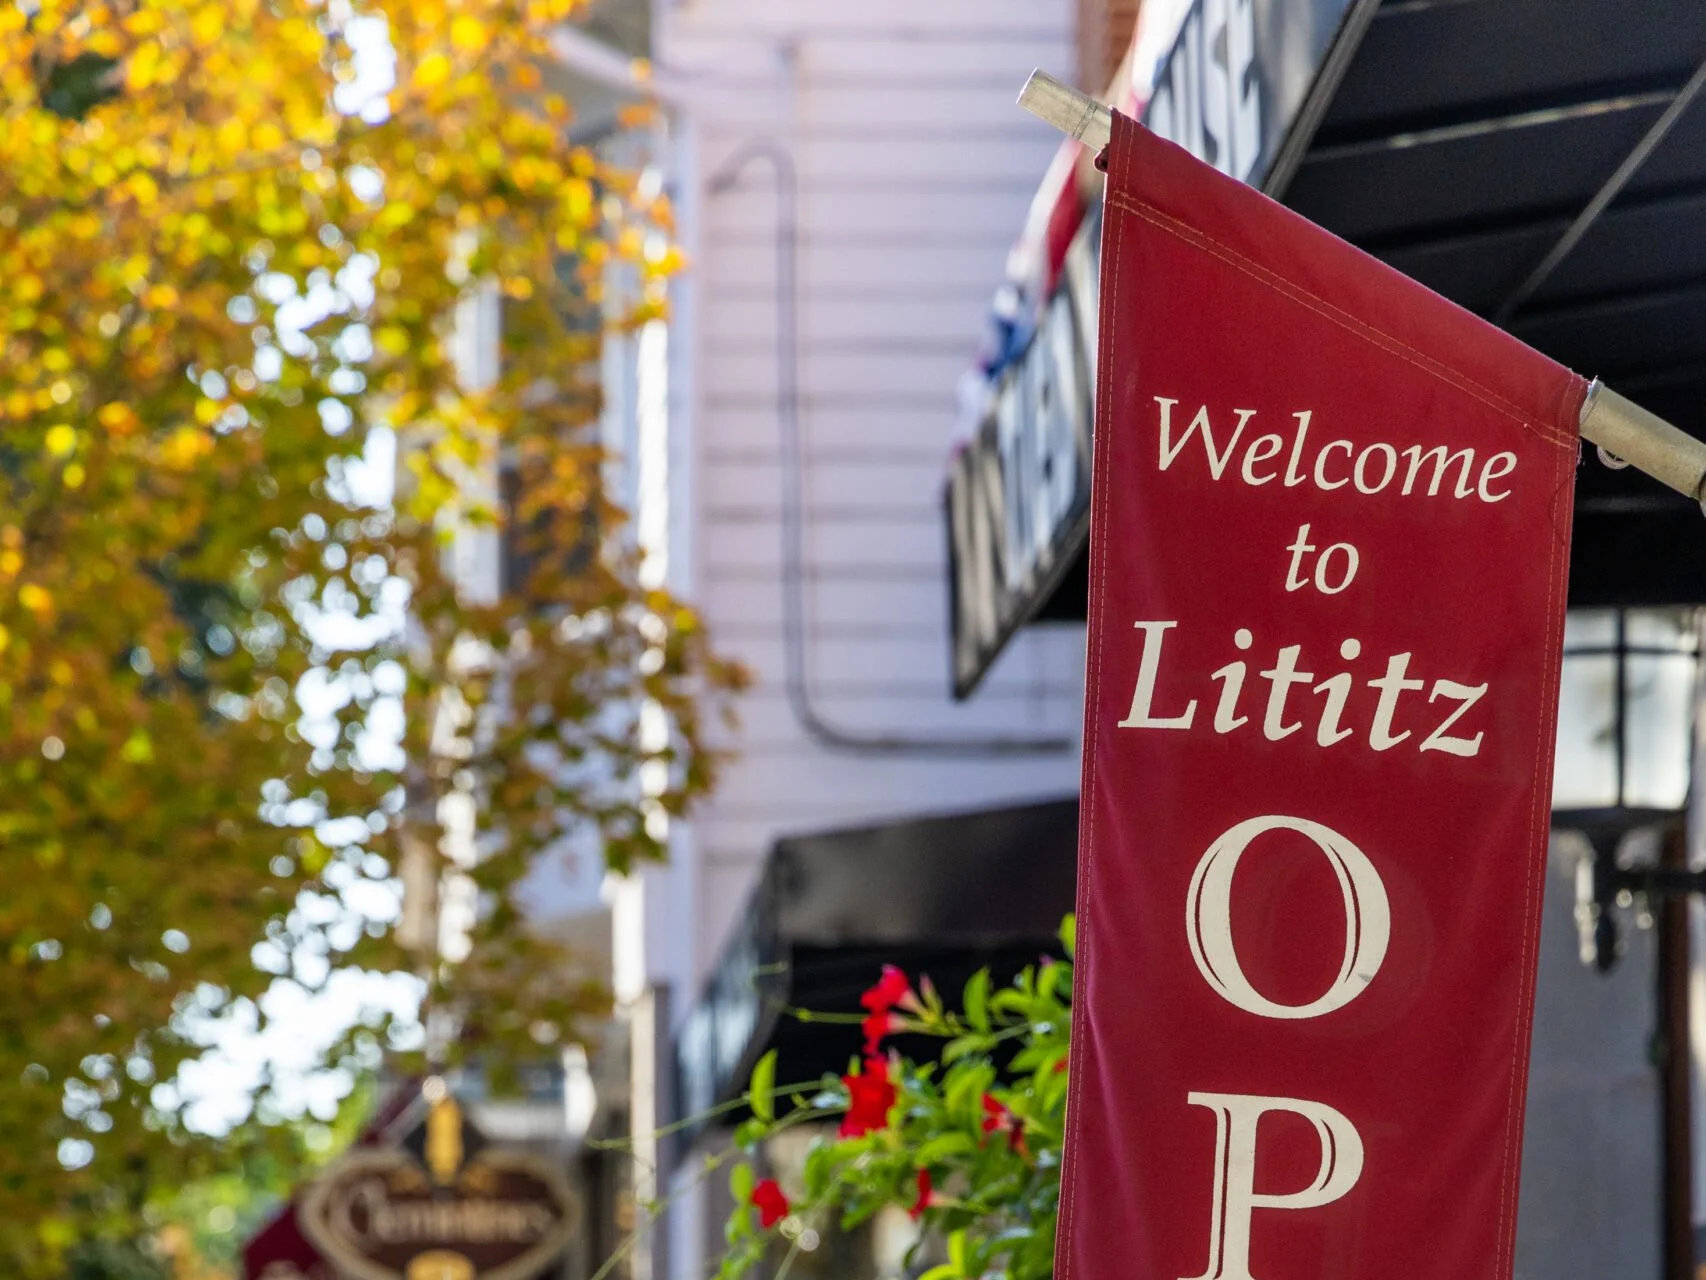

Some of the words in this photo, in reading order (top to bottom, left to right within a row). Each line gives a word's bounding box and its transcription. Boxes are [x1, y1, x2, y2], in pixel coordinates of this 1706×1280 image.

[1154, 396, 1518, 503] Welcome
[1284, 522, 1360, 595] to
[1117, 620, 1489, 758] Lititz
